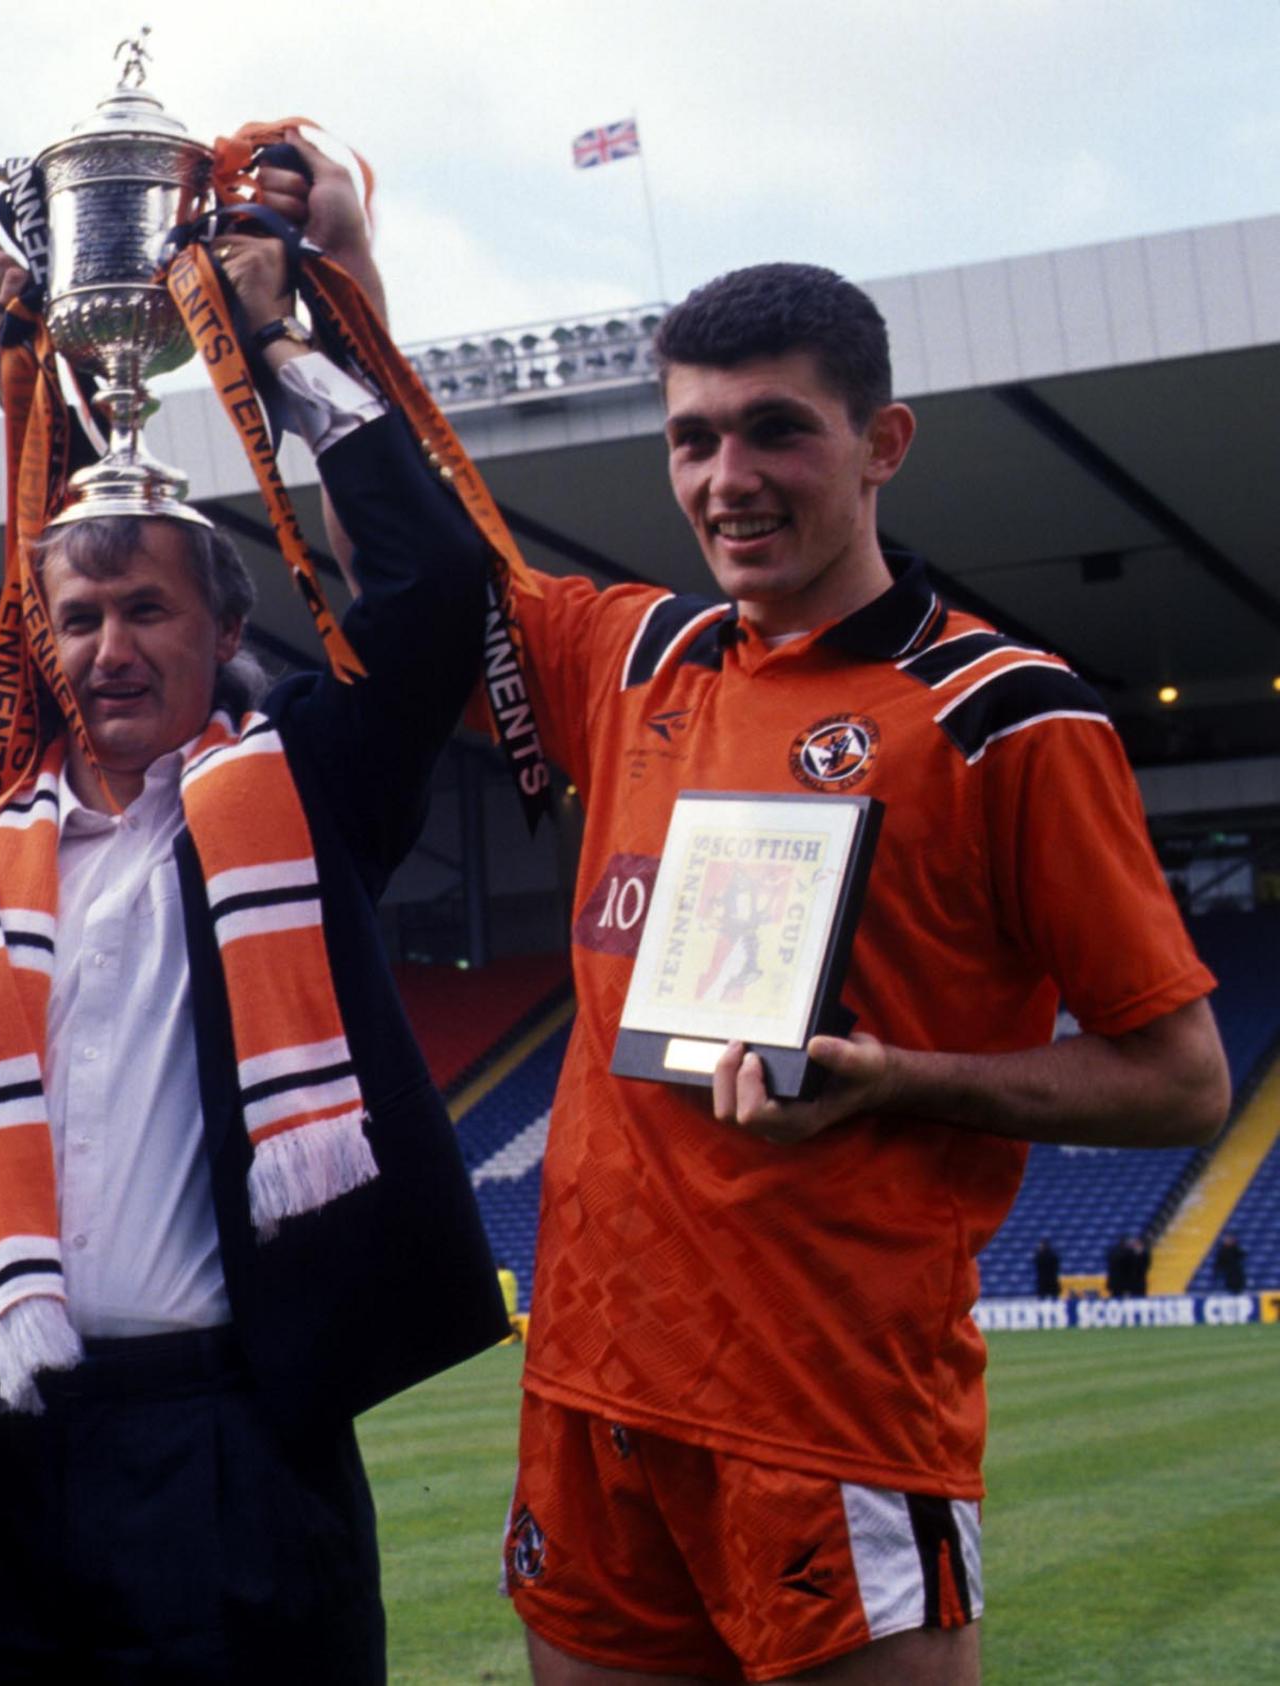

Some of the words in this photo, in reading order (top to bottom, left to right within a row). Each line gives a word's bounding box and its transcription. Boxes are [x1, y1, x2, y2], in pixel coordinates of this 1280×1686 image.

[710, 835, 822, 863] SCOTTISH
[777, 901, 806, 966] CUP
[1076, 1298, 1195, 1329] SCOTTISH
[1203, 1296, 1254, 1326] CUP
